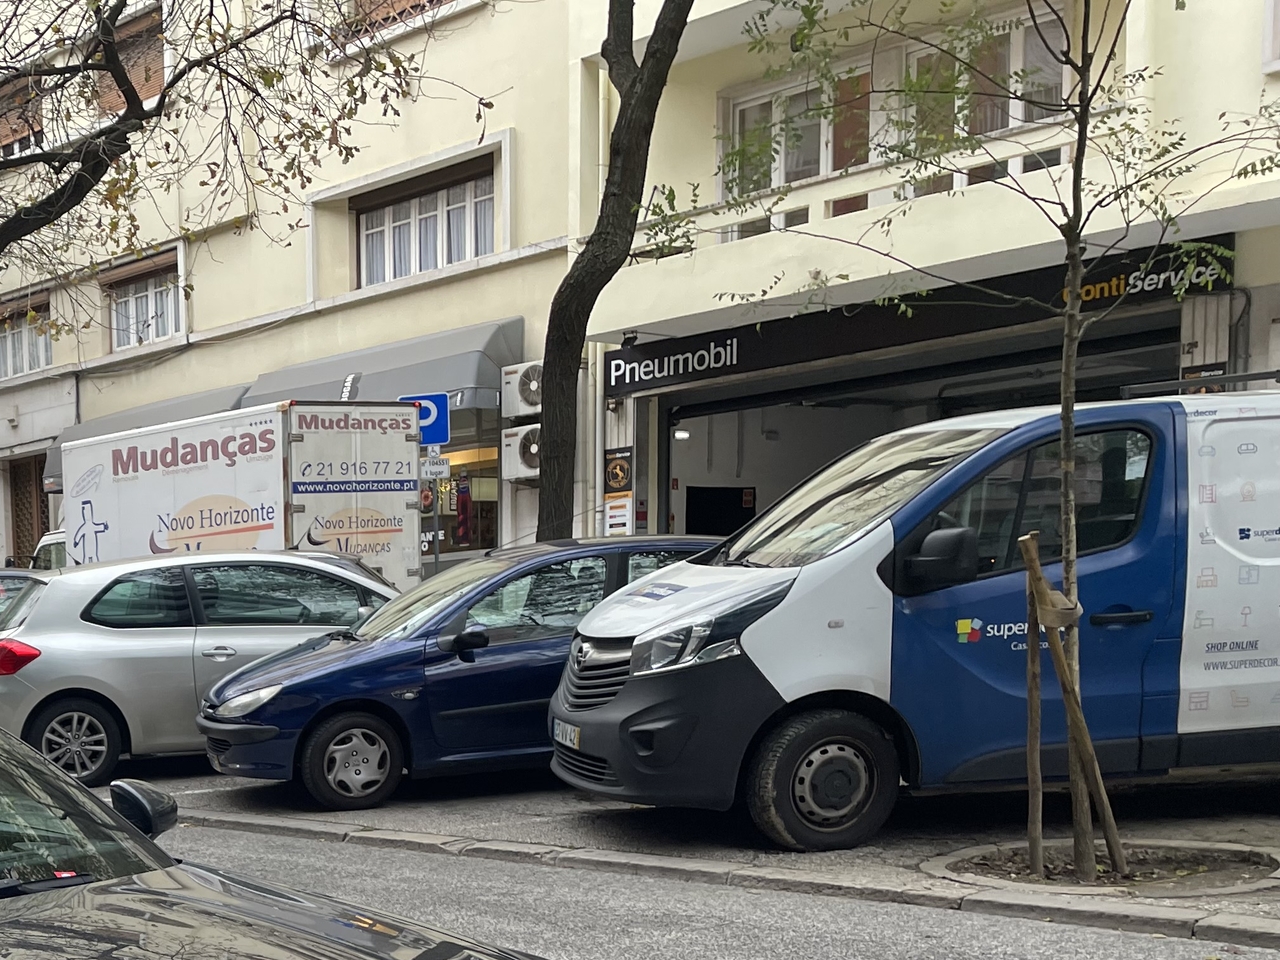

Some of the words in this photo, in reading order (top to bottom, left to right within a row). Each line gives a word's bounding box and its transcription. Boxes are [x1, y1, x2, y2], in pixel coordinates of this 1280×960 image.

[1062, 265, 1220, 302] ontiServce
[610, 338, 738, 386] Pneumobil
[298, 413, 412, 435] Mudanças
[112, 428, 276, 477] Mudanças
[316, 461, 333, 476] 21
[340, 461, 368, 476] 916
[372, 461, 390, 475] 77
[395, 461, 411, 475] 21
[429, 469, 444, 477] lugar
[112, 475, 139, 484] Removals
[297, 481, 414, 493] www.novohorizonte.pt
[156, 512, 195, 533] Novo
[199, 502, 275, 529] Horizonte
[314, 515, 345, 530] Novo
[348, 516, 403, 530] Horizonte
[336, 537, 391, 556] MUDANÇAS
[1205, 642, 1228, 652] SHOP
[1229, 640, 1260, 651] ONLINE
